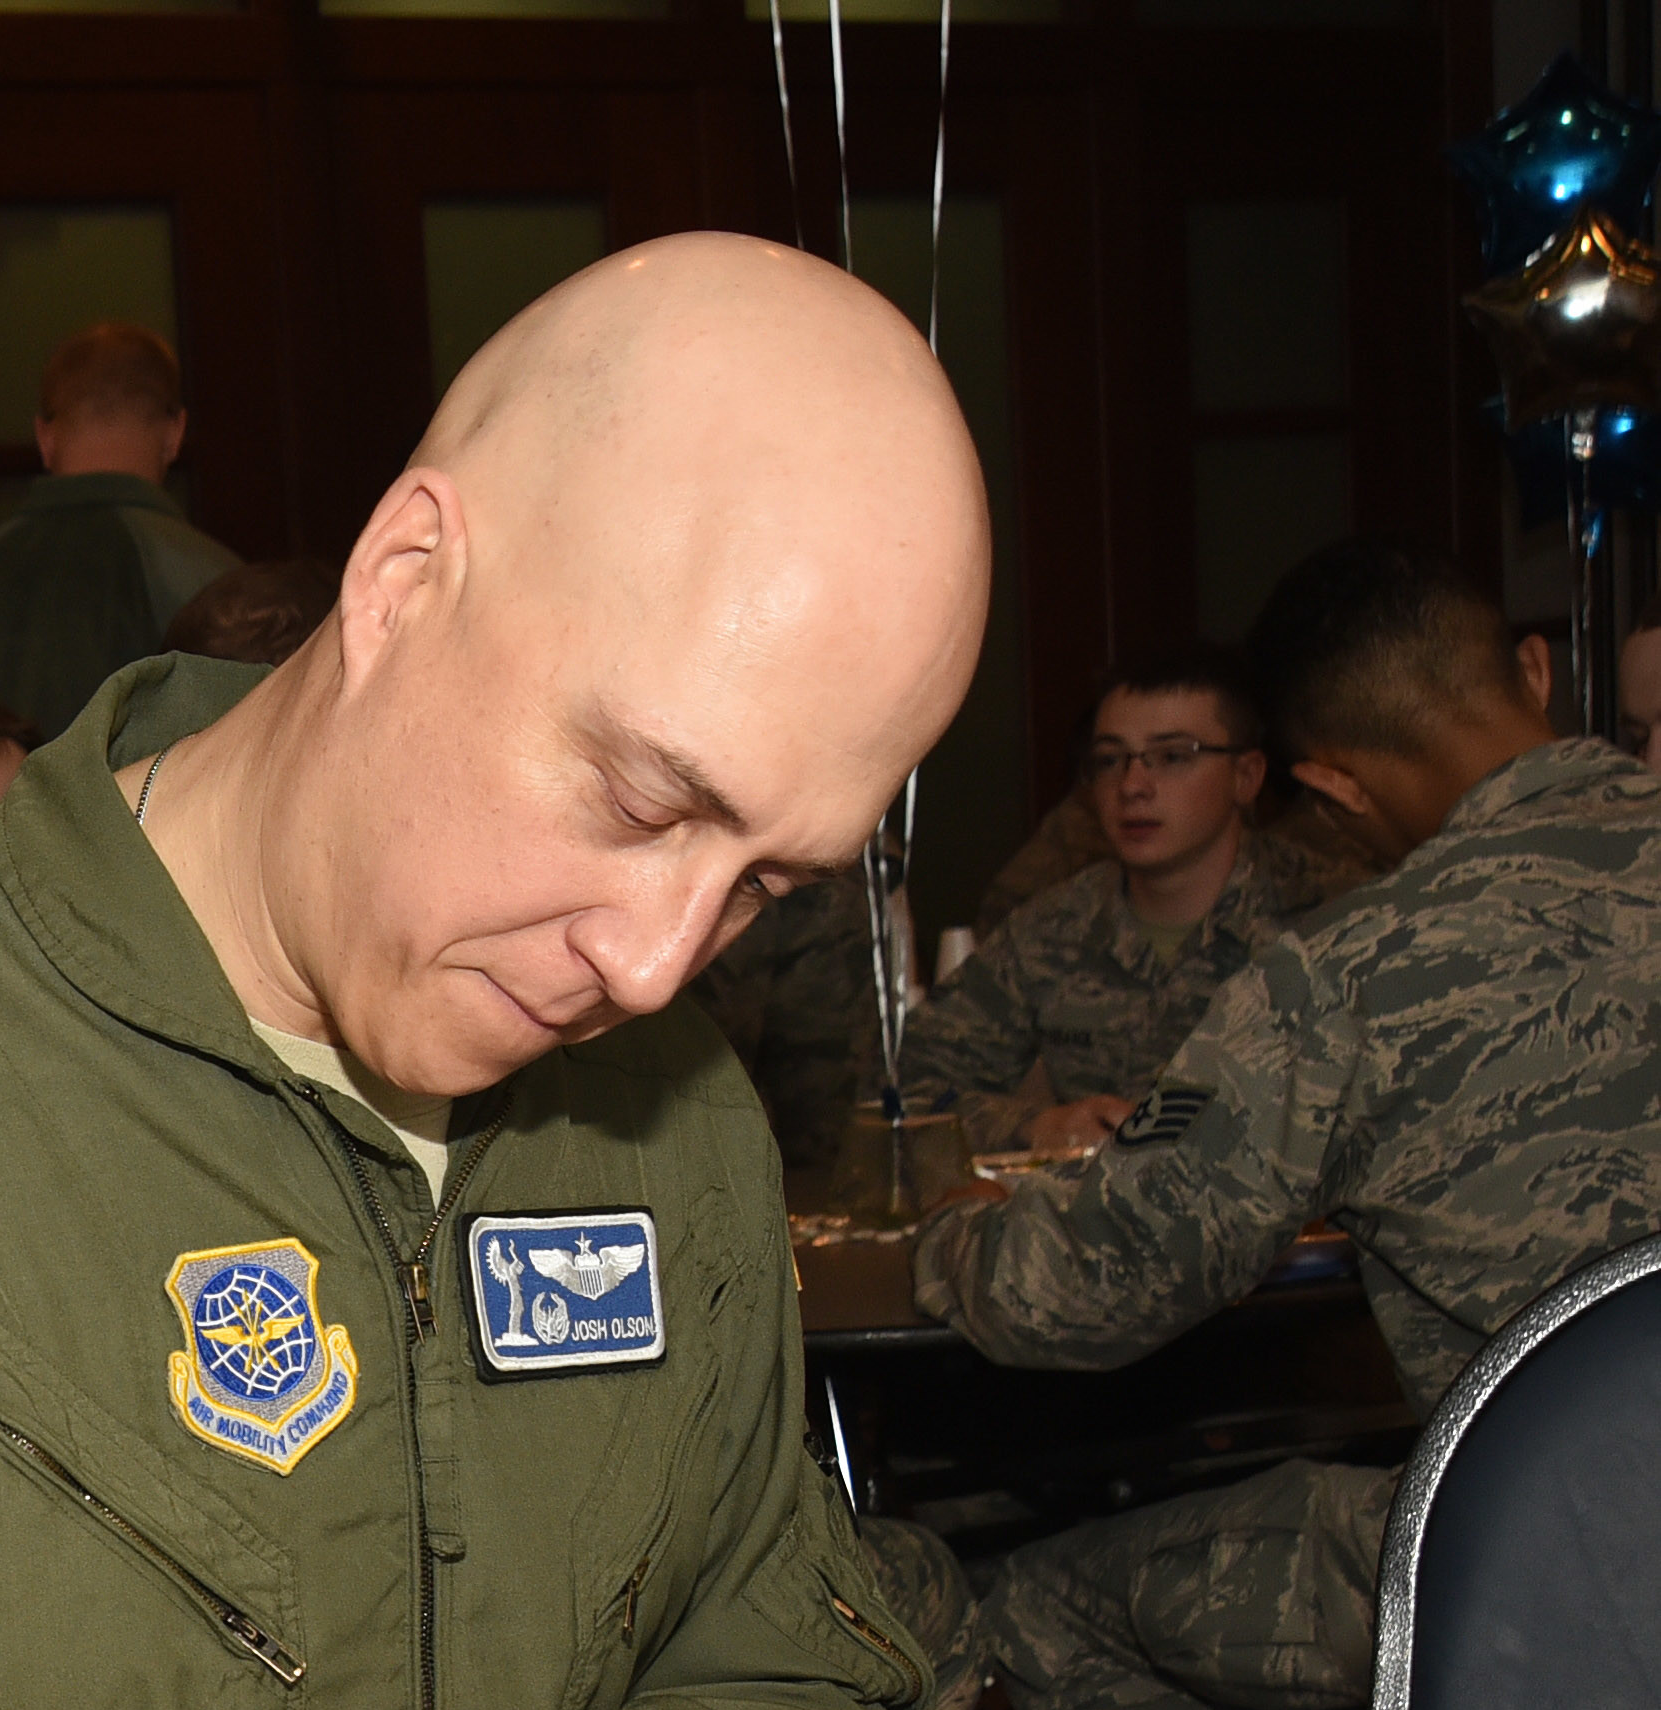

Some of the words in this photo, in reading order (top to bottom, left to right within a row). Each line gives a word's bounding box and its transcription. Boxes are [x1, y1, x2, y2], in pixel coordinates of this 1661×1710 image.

[571, 1318, 607, 1341] JOSH
[611, 1316, 655, 1339] OLSON
[188, 1396, 214, 1428] AIR
[217, 1416, 287, 1455] MOBILITY
[287, 1370, 348, 1444] COMMAND
